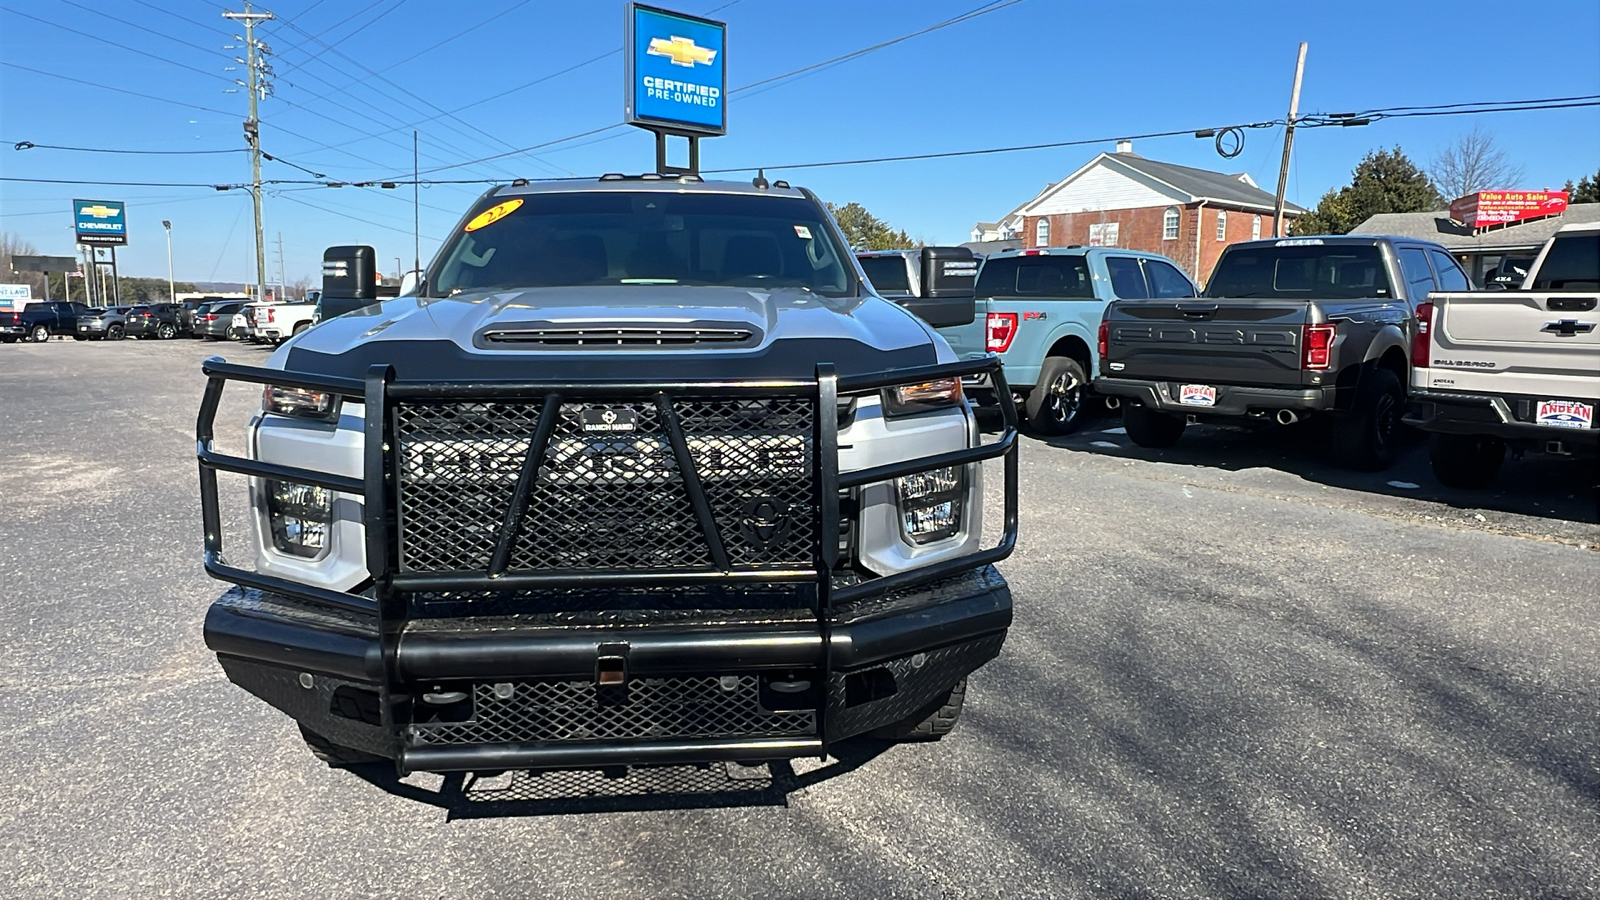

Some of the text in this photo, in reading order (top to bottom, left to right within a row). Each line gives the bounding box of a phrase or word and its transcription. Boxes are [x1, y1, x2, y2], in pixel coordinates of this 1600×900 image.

[643, 76, 720, 98] CERTIFIED
[647, 87, 716, 107] PRE-OWNED
[484, 206, 507, 223] 22
[79, 222, 123, 230] CHEVROLET
[1023, 311, 1047, 321] FX4
[1113, 328, 1297, 347] FORD
[1433, 359, 1496, 368] SILVERADO
[1183, 387, 1214, 399] ANDEAN
[1540, 404, 1591, 421] ANDEAN
